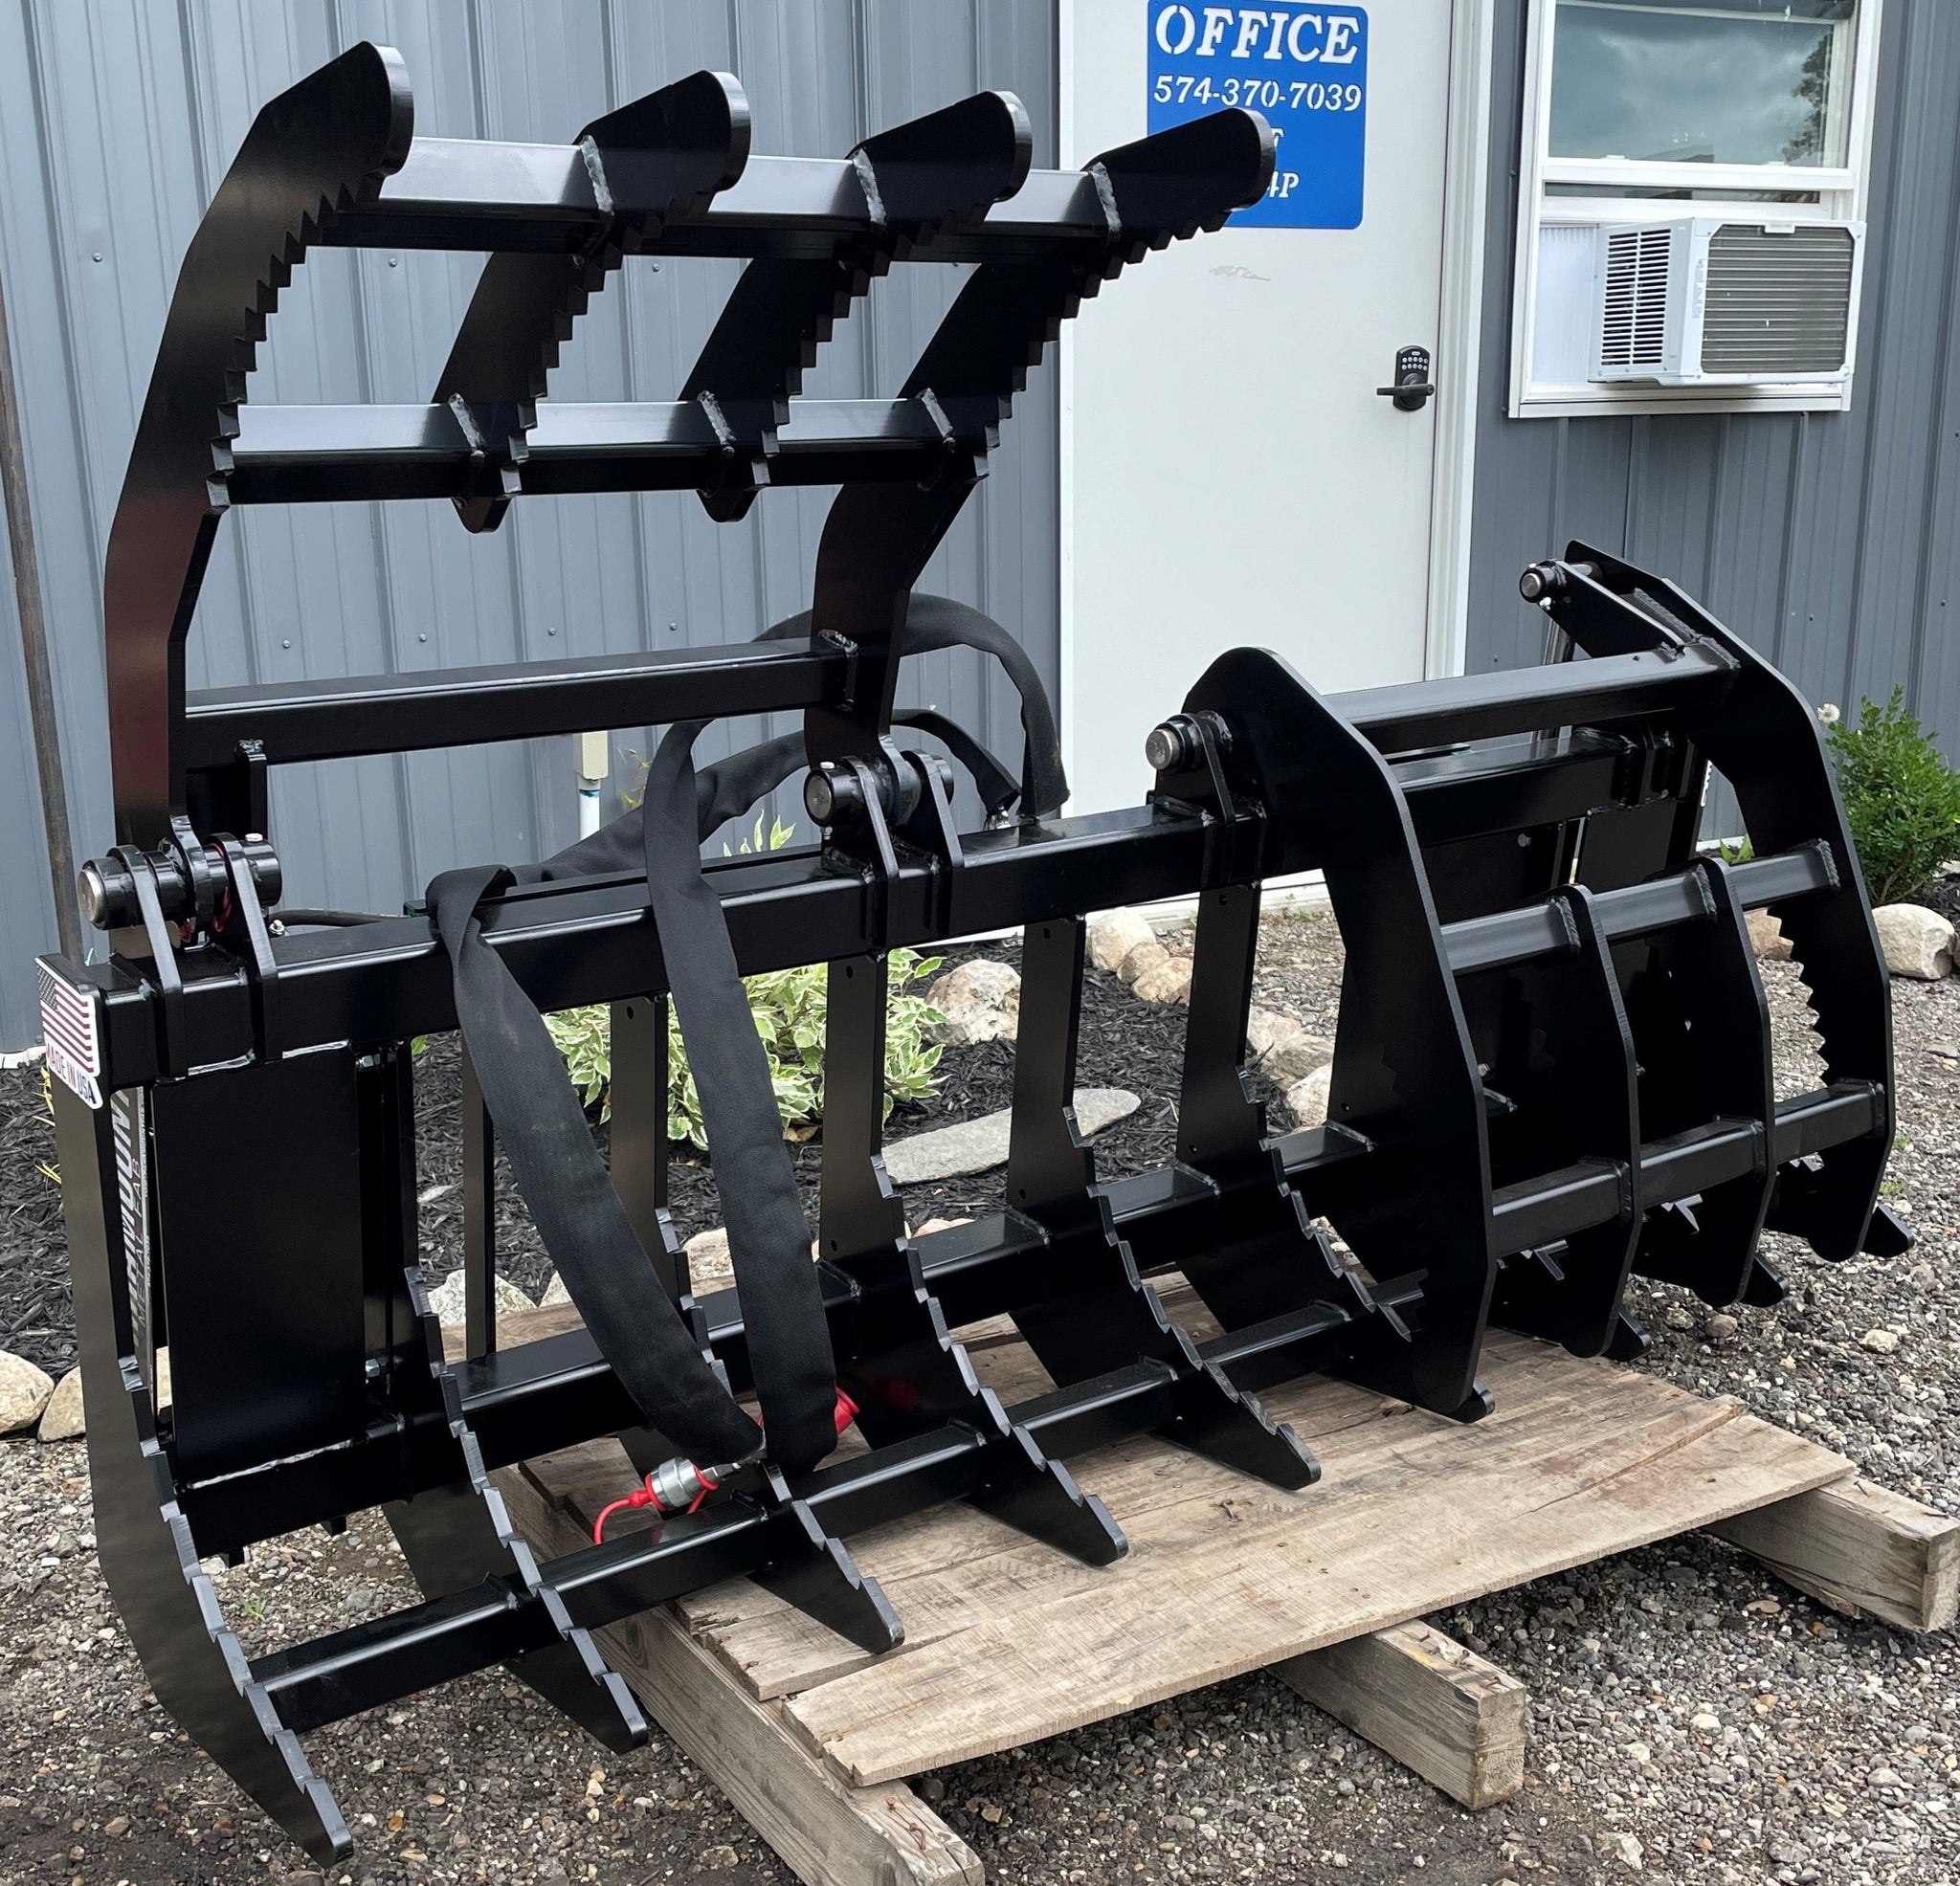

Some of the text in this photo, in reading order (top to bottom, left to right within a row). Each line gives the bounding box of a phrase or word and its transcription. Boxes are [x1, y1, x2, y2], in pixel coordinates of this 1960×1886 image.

[1155, 4, 1360, 64] OFFICE
[1153, 75, 1362, 112] 574-370-7039
[67, 1060, 77, 1089] IN
[77, 1070, 97, 1104] USA
[132, 1156, 146, 1328] METAL FAB
